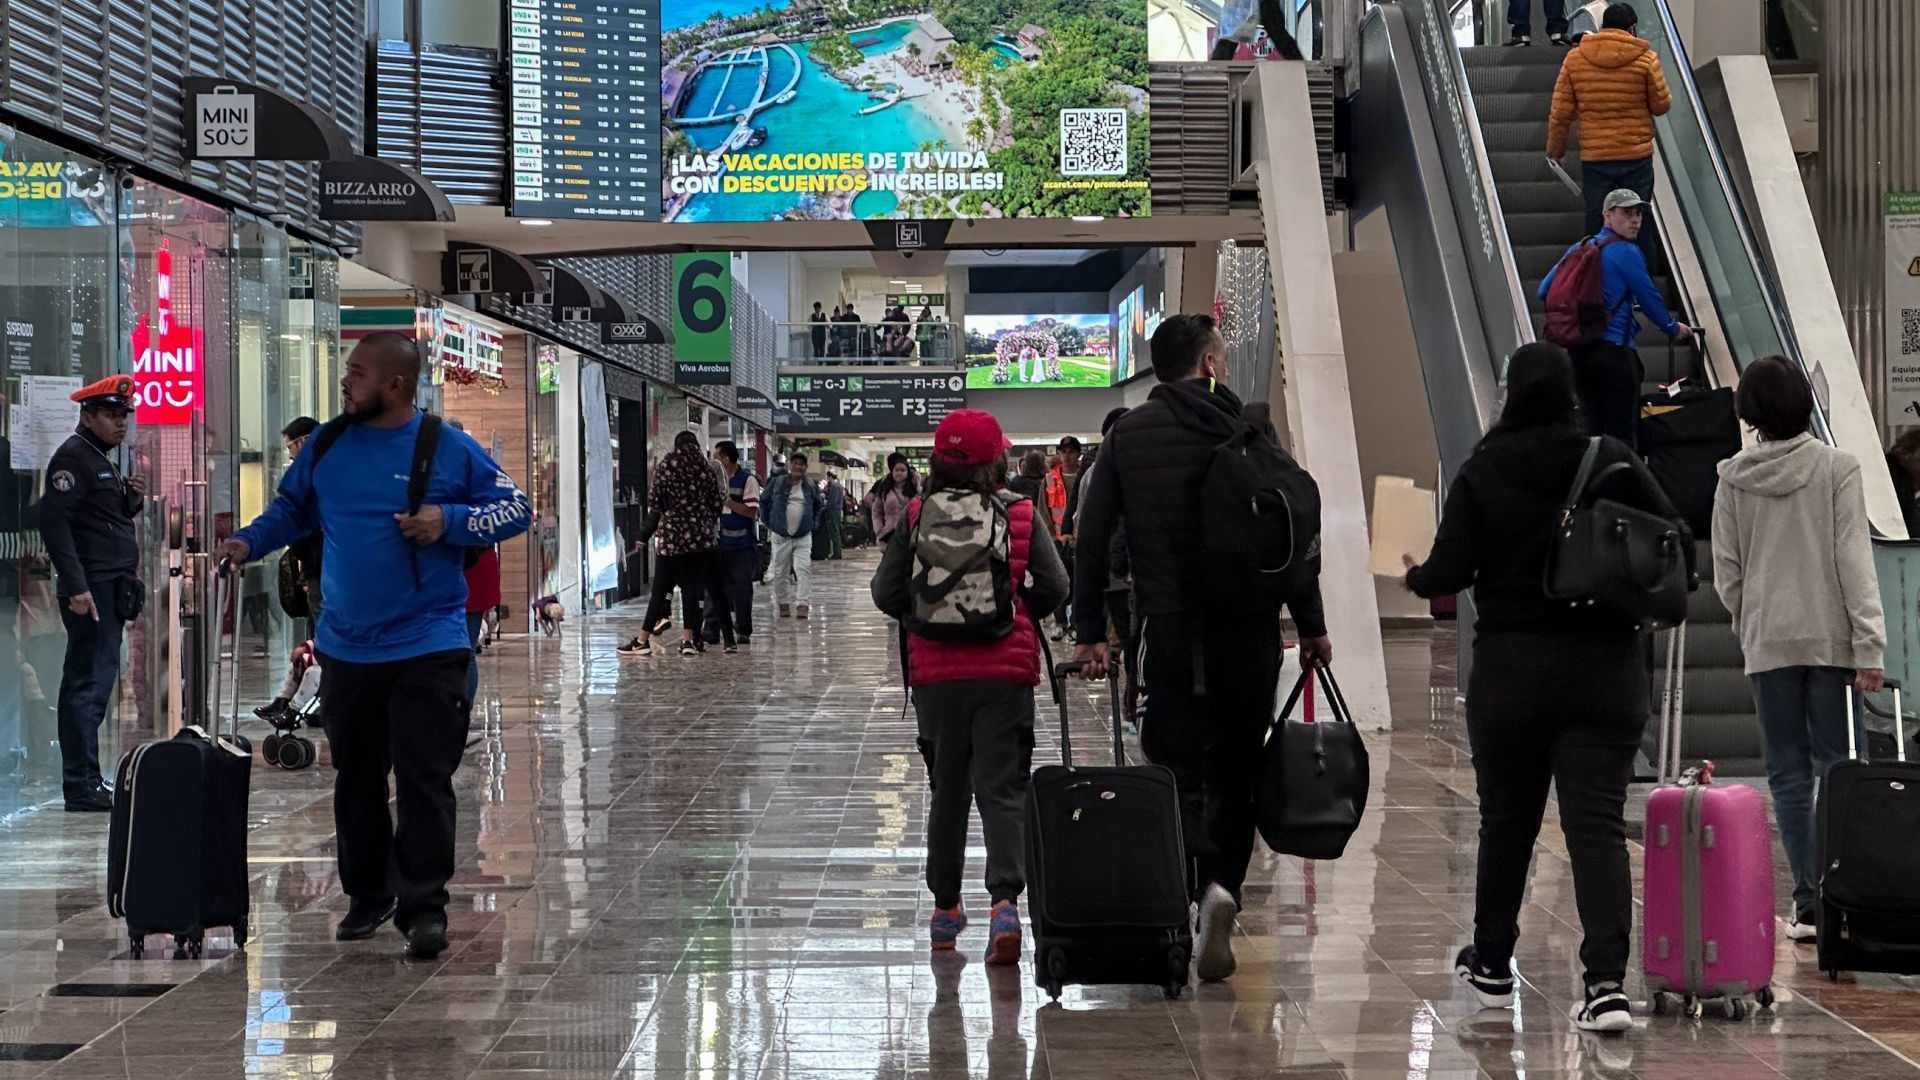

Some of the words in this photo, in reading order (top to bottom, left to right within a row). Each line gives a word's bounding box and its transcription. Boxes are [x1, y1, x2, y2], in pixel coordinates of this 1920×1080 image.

[203, 108, 248, 124] MINI
[672, 154, 720, 176] ¡LAS
[723, 153, 865, 171] VACACIONES
[868, 151, 897, 169] DE
[902, 151, 931, 169] TU
[931, 151, 990, 169] VIDA
[325, 182, 416, 197] BIZZARRO
[671, 176, 720, 194] CON
[723, 174, 868, 193] DESCUENTOS
[871, 172, 1004, 191] INCREÍBLES!
[678, 259, 726, 334] 6
[612, 325, 645, 336] OXXO
[680, 364, 696, 373] Viva
[698, 364, 730, 373] Aerobus
[914, 378, 946, 389] F1-F3
[839, 399, 863, 416] F2
[902, 398, 926, 416] F3
